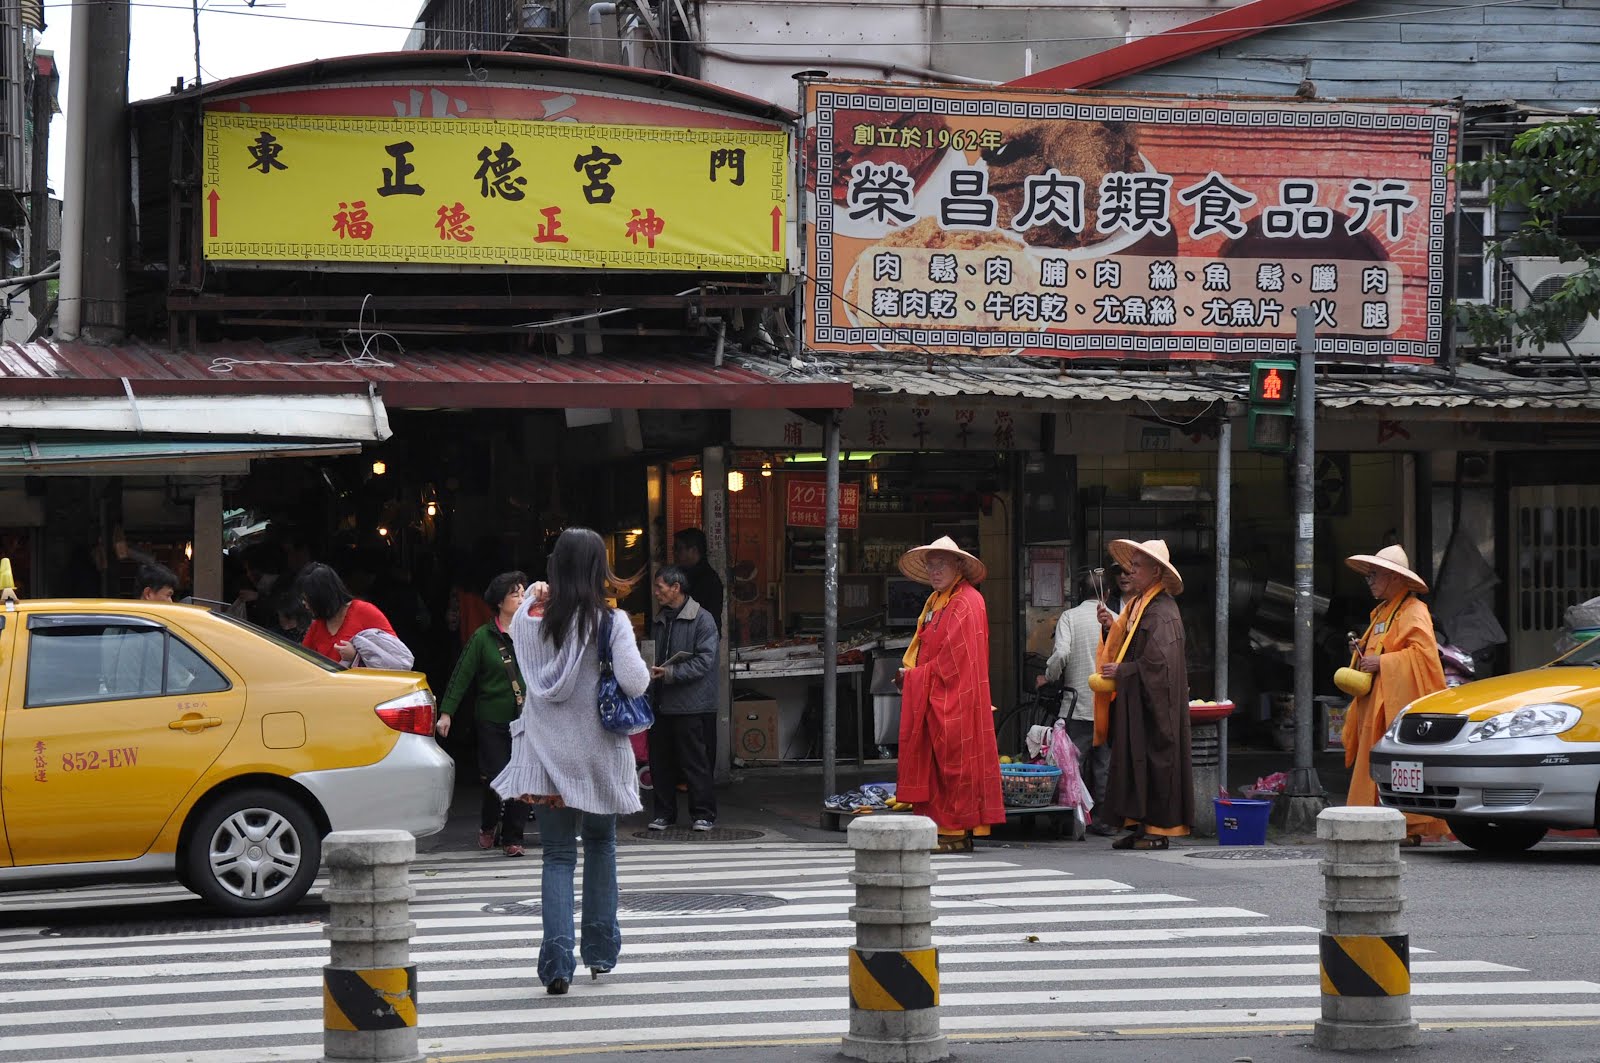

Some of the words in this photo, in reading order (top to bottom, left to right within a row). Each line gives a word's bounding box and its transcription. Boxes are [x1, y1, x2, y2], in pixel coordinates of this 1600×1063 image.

[247, 131, 289, 174] 東
[709, 147, 746, 187] 門
[853, 124, 1002, 151] 創立於1962年
[332, 200, 666, 249] 福德正神
[847, 164, 1417, 239] 榮昌肉類食品行
[62, 746, 139, 772] 852-EW
